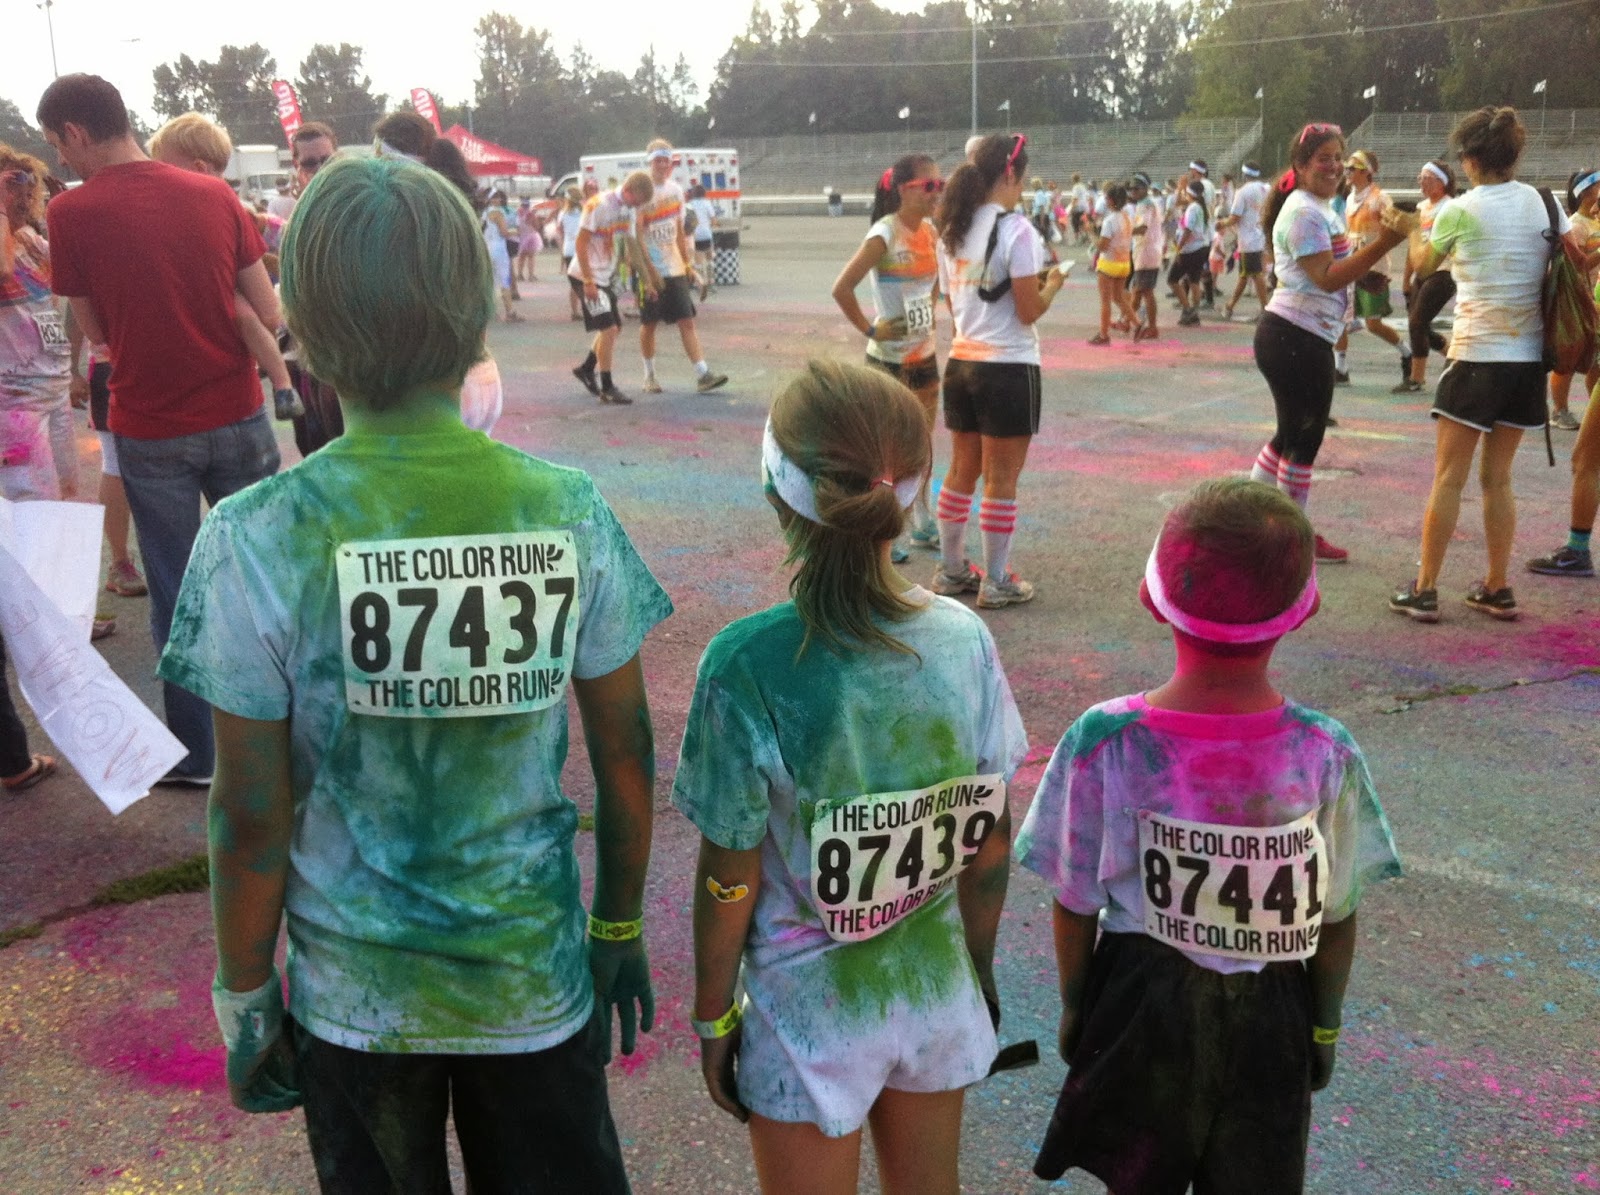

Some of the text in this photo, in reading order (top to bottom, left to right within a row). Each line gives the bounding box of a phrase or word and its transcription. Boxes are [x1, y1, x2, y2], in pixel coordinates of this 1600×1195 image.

[358, 543, 547, 584] THE COLOR RUN
[350, 577, 575, 674] 87437
[366, 668, 552, 708] THE COLOR RUN
[832, 784, 974, 833] THE COLOR RUN
[817, 810, 996, 905] 87439
[1150, 821, 1304, 860] THE COLOR RUN
[1144, 848, 1322, 926] 87441
[827, 906, 866, 934] THE
[869, 889, 924, 929] COLOR
[1155, 911, 1308, 954] THE COLOR RUN
